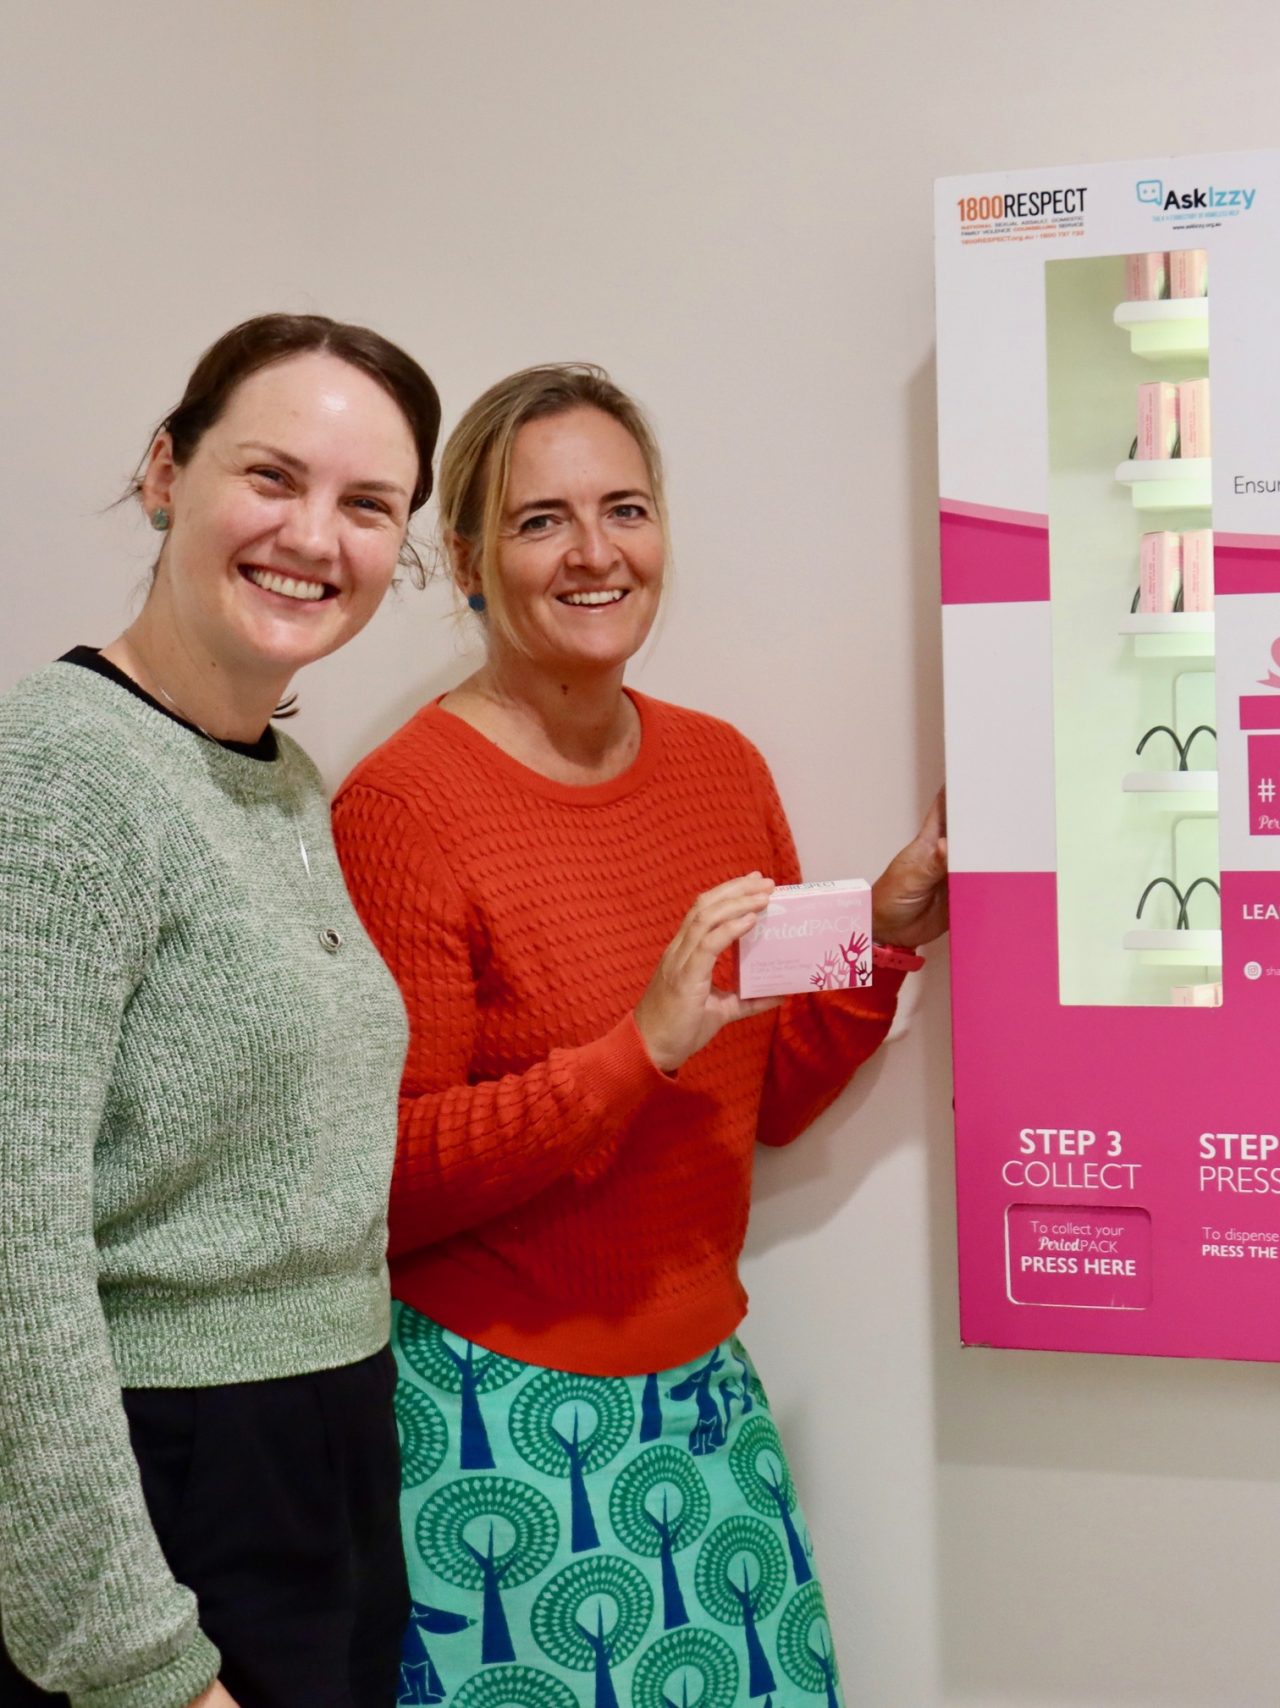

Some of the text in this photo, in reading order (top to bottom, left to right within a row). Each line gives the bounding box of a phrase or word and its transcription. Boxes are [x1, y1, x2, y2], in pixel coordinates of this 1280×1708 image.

[957, 188, 1087, 222] 1800RESPECT
[1020, 1129, 1122, 1156] STEP 3
[1199, 1133, 1278, 1161] STEP
[1002, 1161, 1141, 1189] COLLECT
[1030, 1221, 1124, 1240] To collect your
[1202, 1227, 1220, 1240] To
[1225, 1228, 1279, 1244] dispense
[1038, 1236, 1118, 1253] PeriodPACK
[1202, 1244, 1244, 1258] PRESS
[1249, 1245, 1277, 1259] THE
[1021, 1256, 1136, 1276] PRESS HERE
